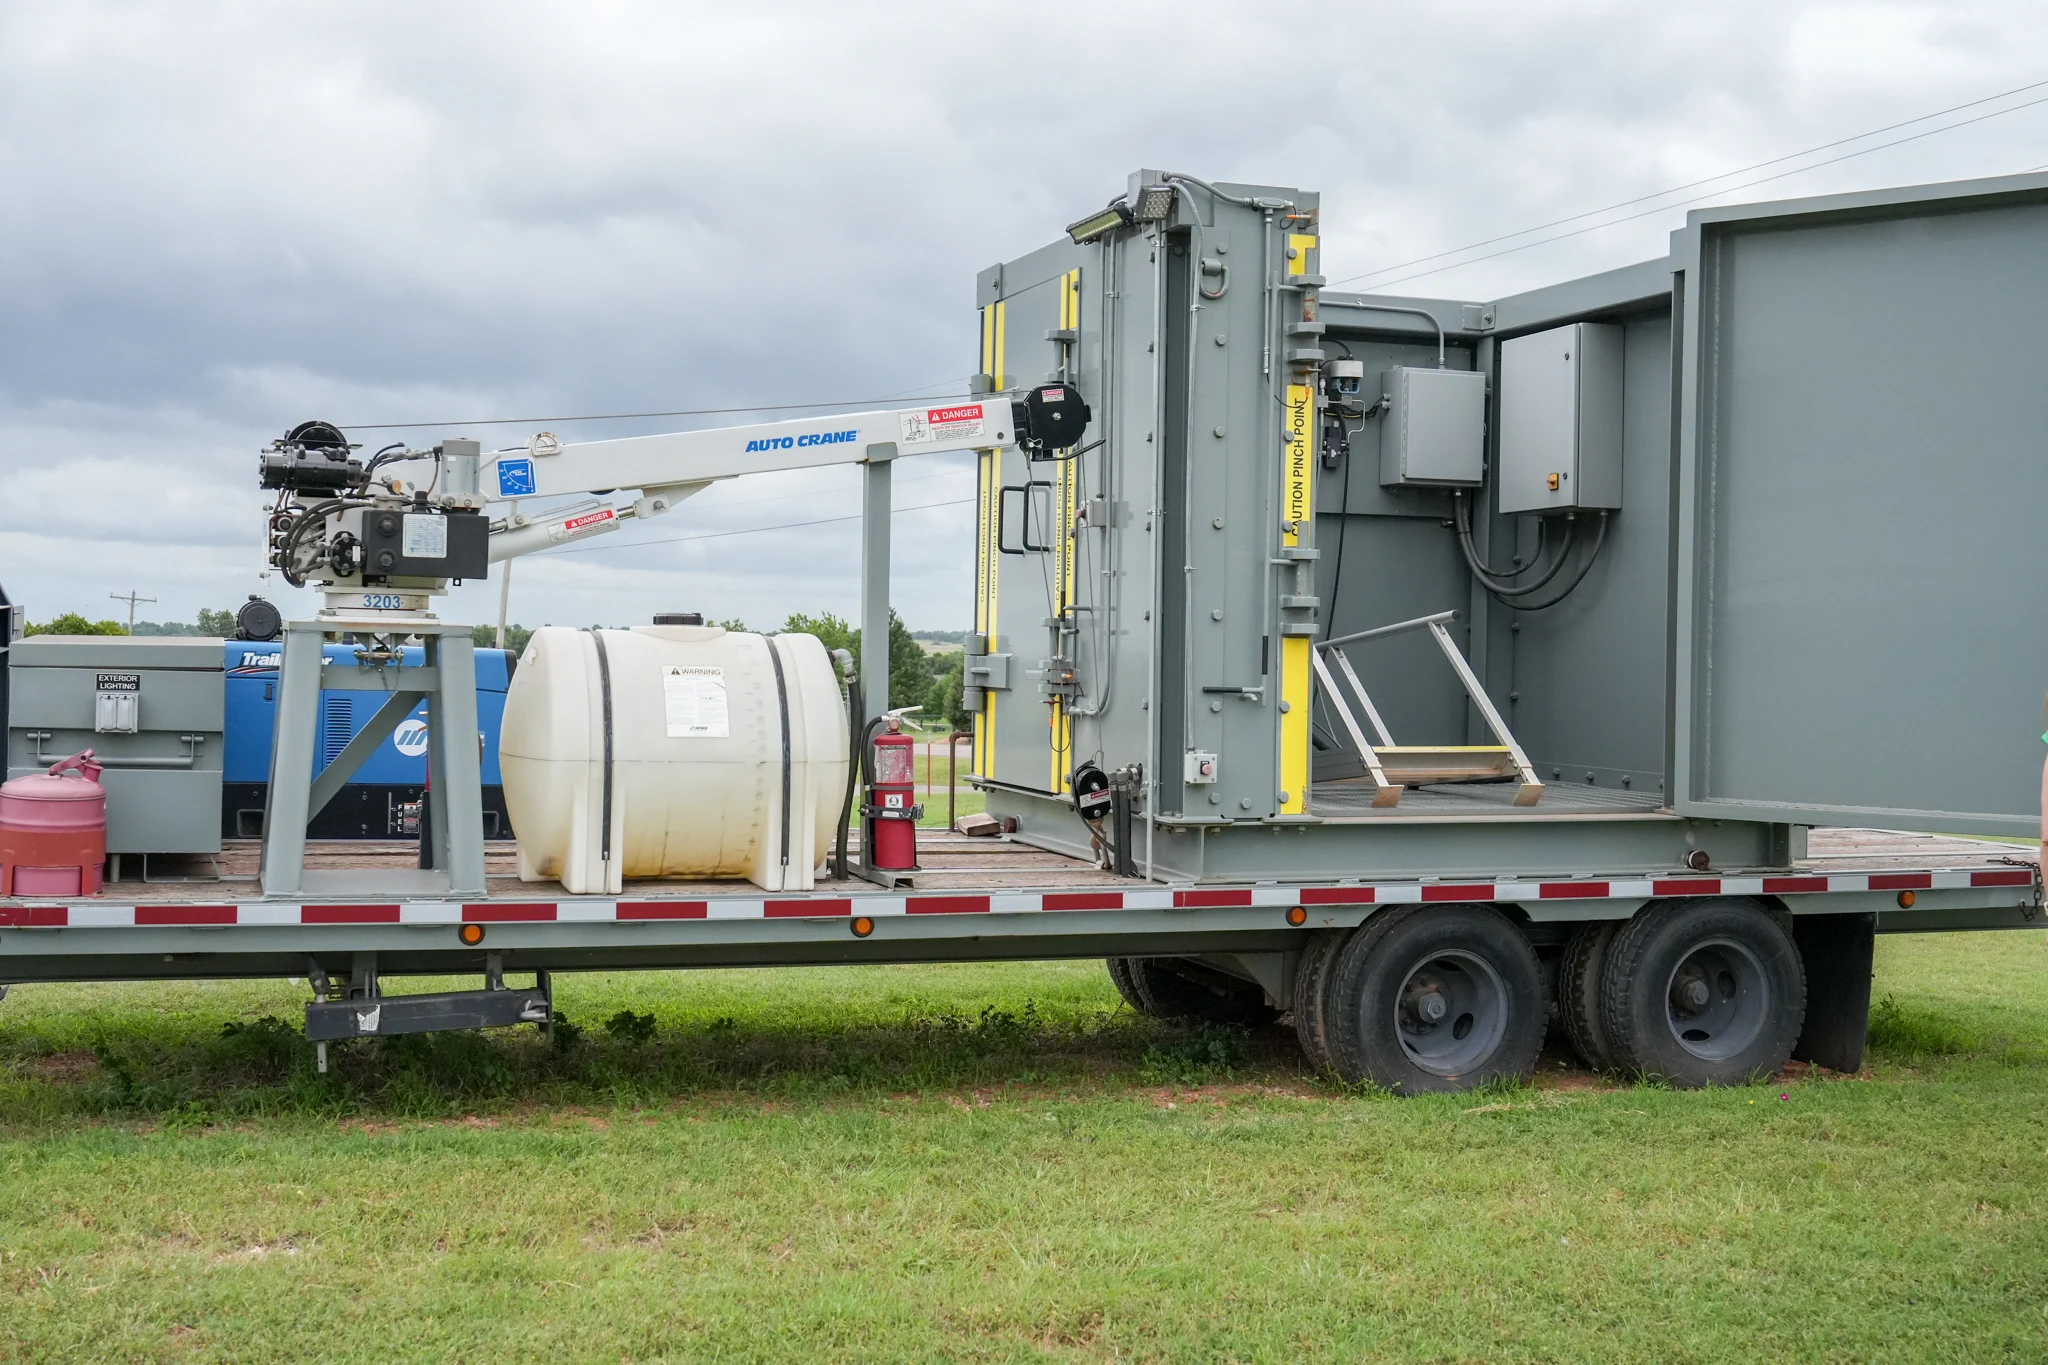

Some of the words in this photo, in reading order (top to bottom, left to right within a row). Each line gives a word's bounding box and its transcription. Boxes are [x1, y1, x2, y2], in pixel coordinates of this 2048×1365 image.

[942, 408, 979, 420] DANGER
[1294, 398, 1305, 436] POINT
[745, 437, 794, 453] AUTO
[797, 430, 857, 447] CRANE
[1293, 440, 1304, 477] PINCH
[578, 512, 609, 525] DANGER
[363, 594, 401, 609] 3203
[99, 674, 138, 682] EXTERIOR
[681, 668, 721, 676] WARNING
[100, 682, 136, 690] LIGHTING
